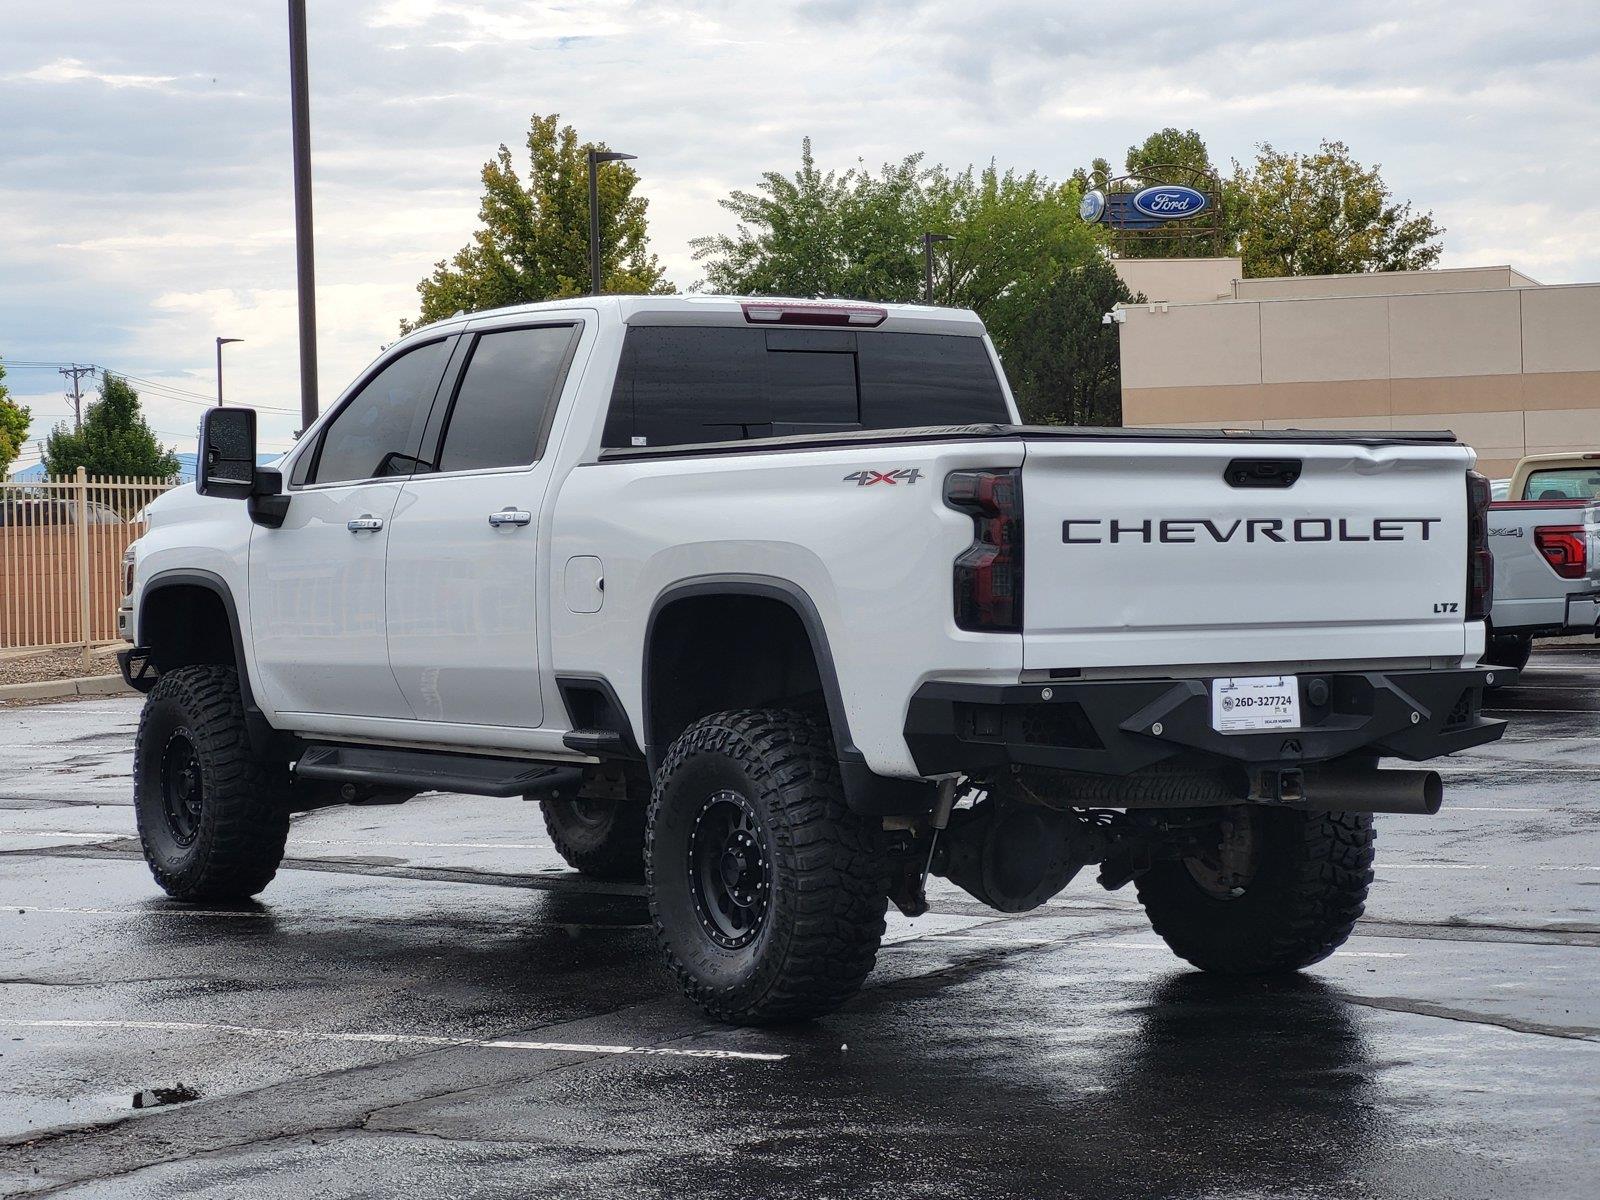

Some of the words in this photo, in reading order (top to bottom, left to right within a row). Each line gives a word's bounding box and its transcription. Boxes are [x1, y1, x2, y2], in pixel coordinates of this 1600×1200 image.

[1151, 193, 1190, 211] Ford
[1061, 517, 1442, 544] CHEVROLET
[1433, 602, 1459, 614] LTZ
[1235, 696, 1292, 707] 26D-327724
